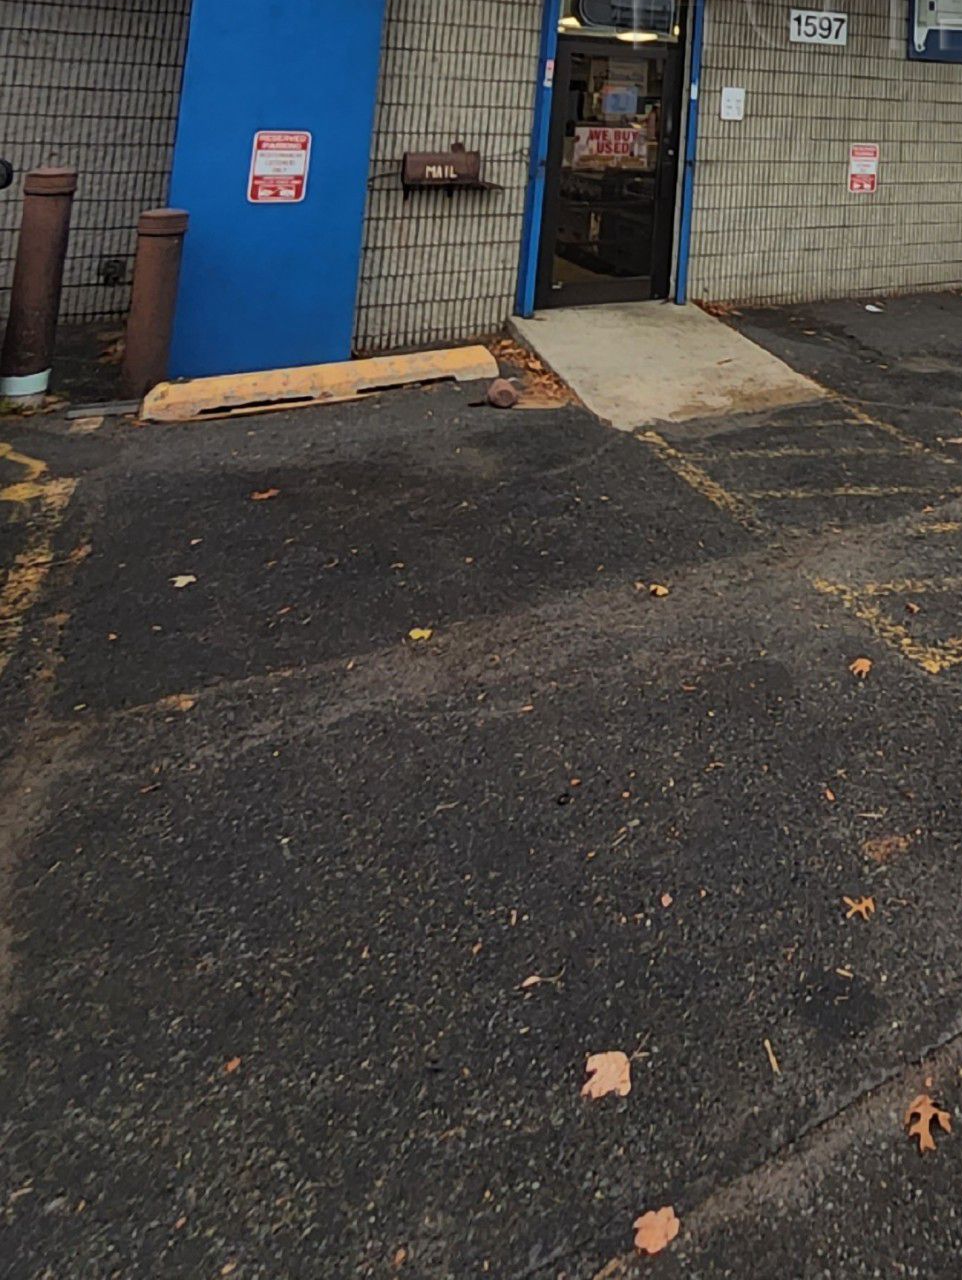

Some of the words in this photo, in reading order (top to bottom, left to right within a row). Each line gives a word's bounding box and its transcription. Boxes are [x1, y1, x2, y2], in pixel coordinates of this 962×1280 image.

[793, 14, 846, 40] 1597
[589, 129, 609, 142] WE
[614, 130, 640, 142] BUY
[597, 143, 629, 154] USED
[425, 165, 458, 179] MAIL
